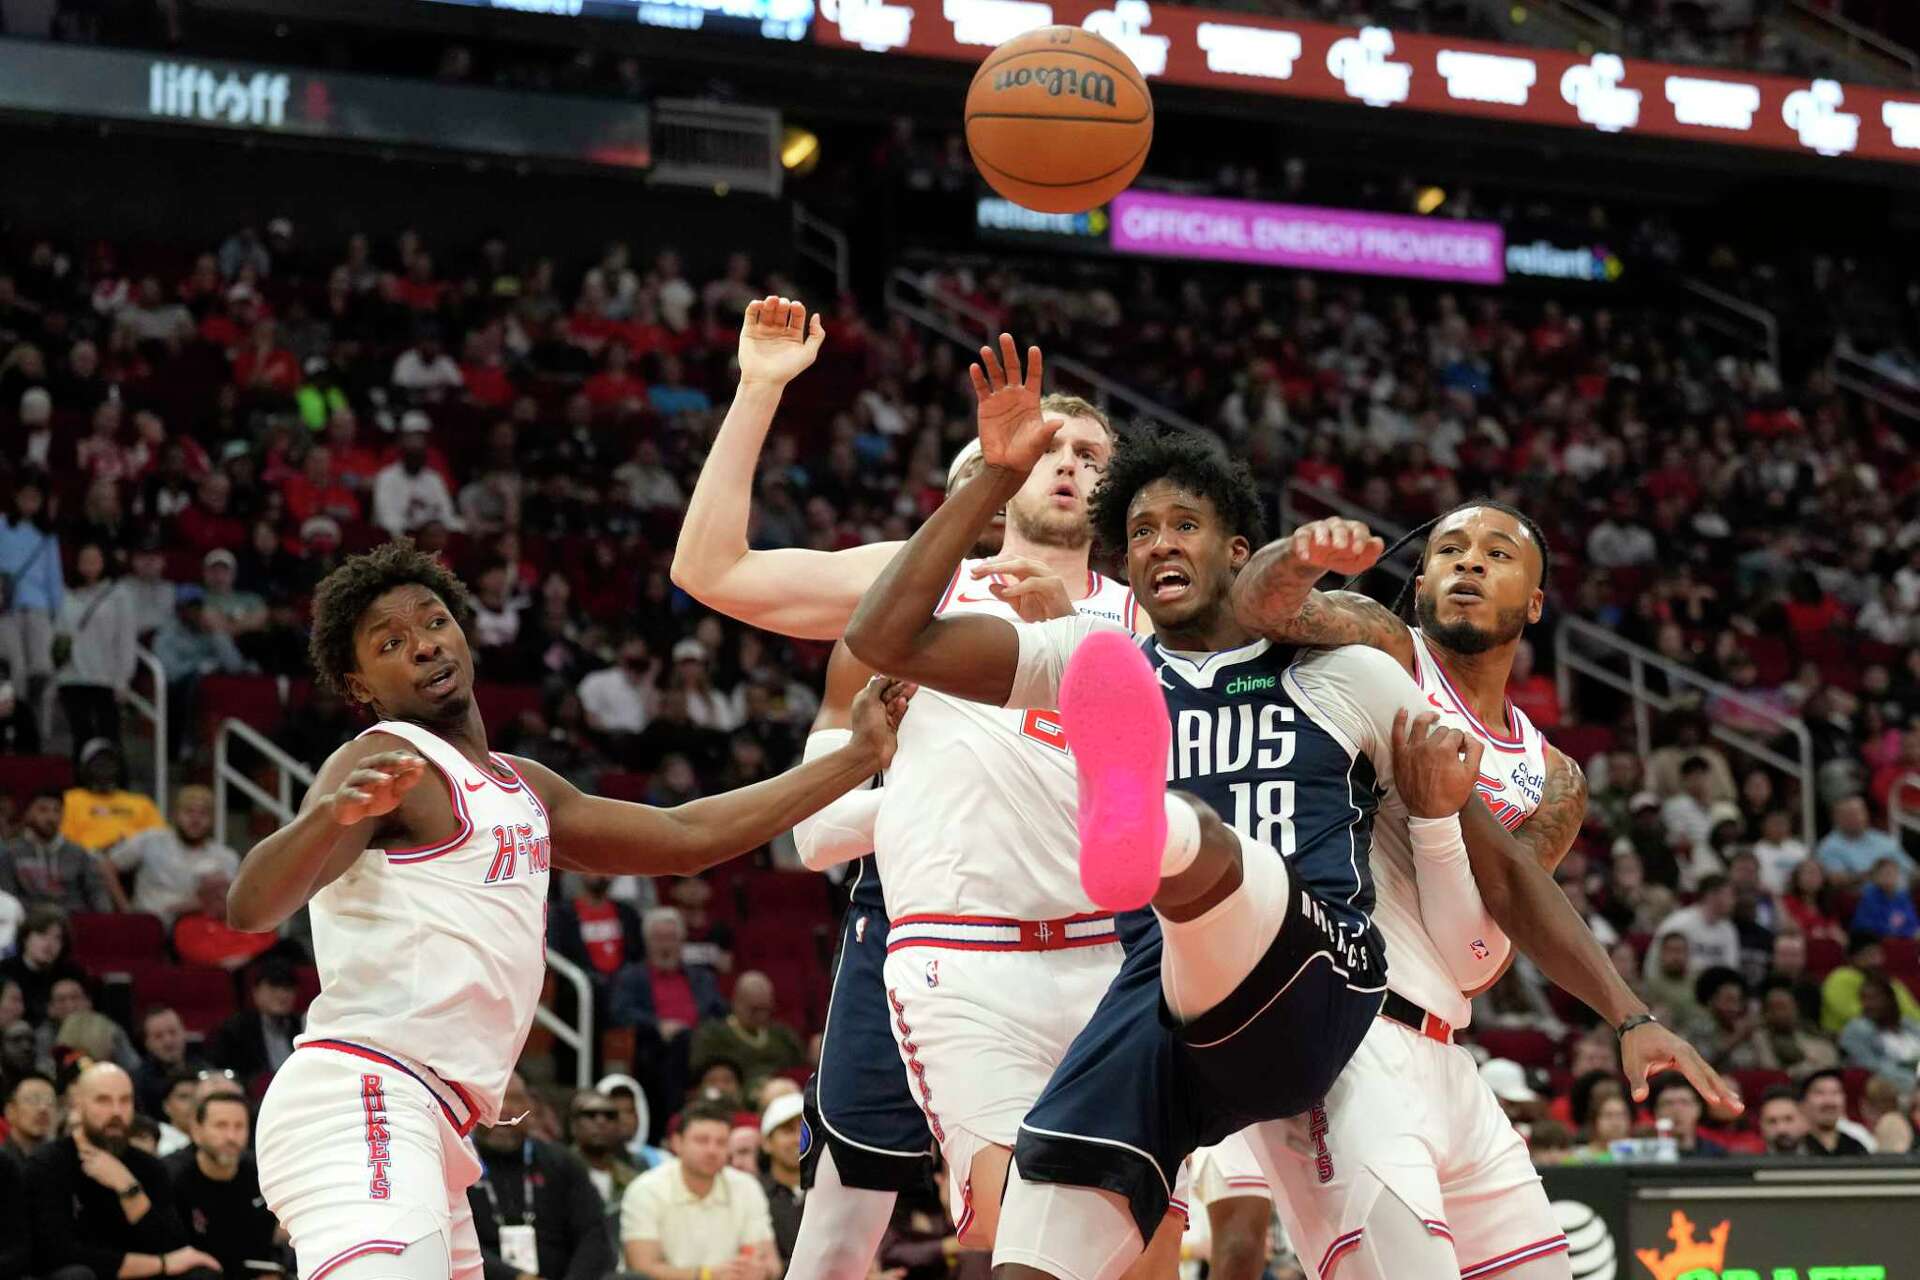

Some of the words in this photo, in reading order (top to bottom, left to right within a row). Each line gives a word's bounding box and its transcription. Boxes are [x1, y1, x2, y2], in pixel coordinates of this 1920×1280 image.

[151, 61, 290, 126] liftoff
[994, 66, 1117, 107] Wilson
[1121, 205, 1251, 248] OFFICIAL
[1251, 215, 1357, 258] ENERGY
[1360, 226, 1493, 268] PROVIDER
[1506, 240, 1593, 280] reliant
[1079, 607, 1122, 622] credit
[1226, 675, 1276, 695] chime
[1167, 703, 1296, 782] AVS
[1511, 768, 1542, 805] kama
[1229, 780, 1296, 857] 18
